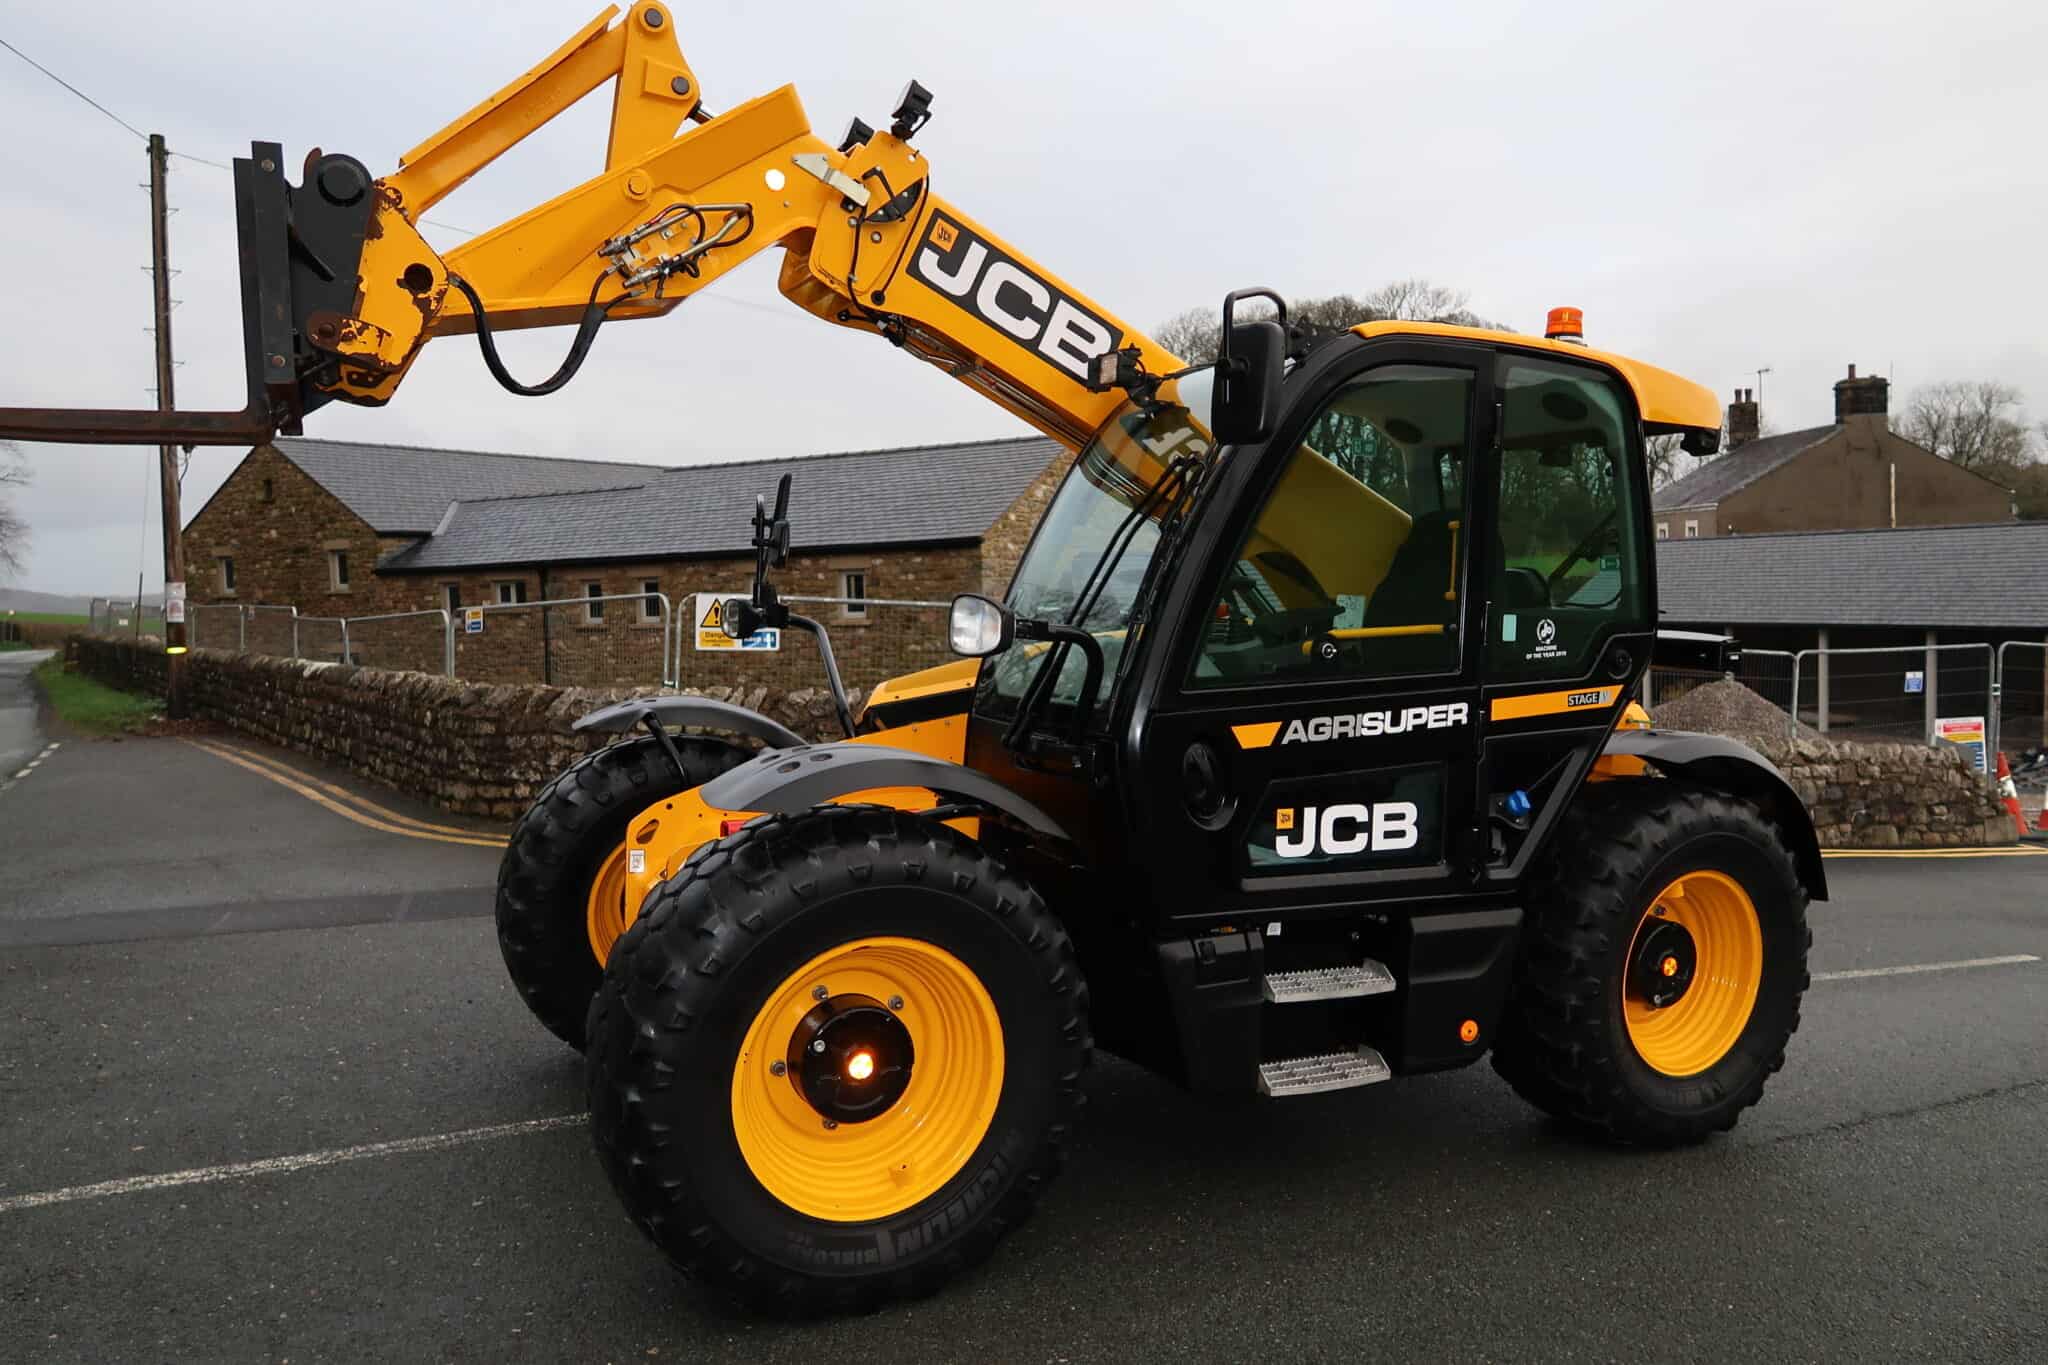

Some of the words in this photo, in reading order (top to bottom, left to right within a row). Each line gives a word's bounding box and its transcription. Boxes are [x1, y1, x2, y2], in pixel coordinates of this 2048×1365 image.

[918, 240, 1112, 380] JCB
[1281, 702, 1469, 745] AGRISUPER
[1568, 692, 1599, 706] STAGE
[1276, 802, 1418, 858] JCB
